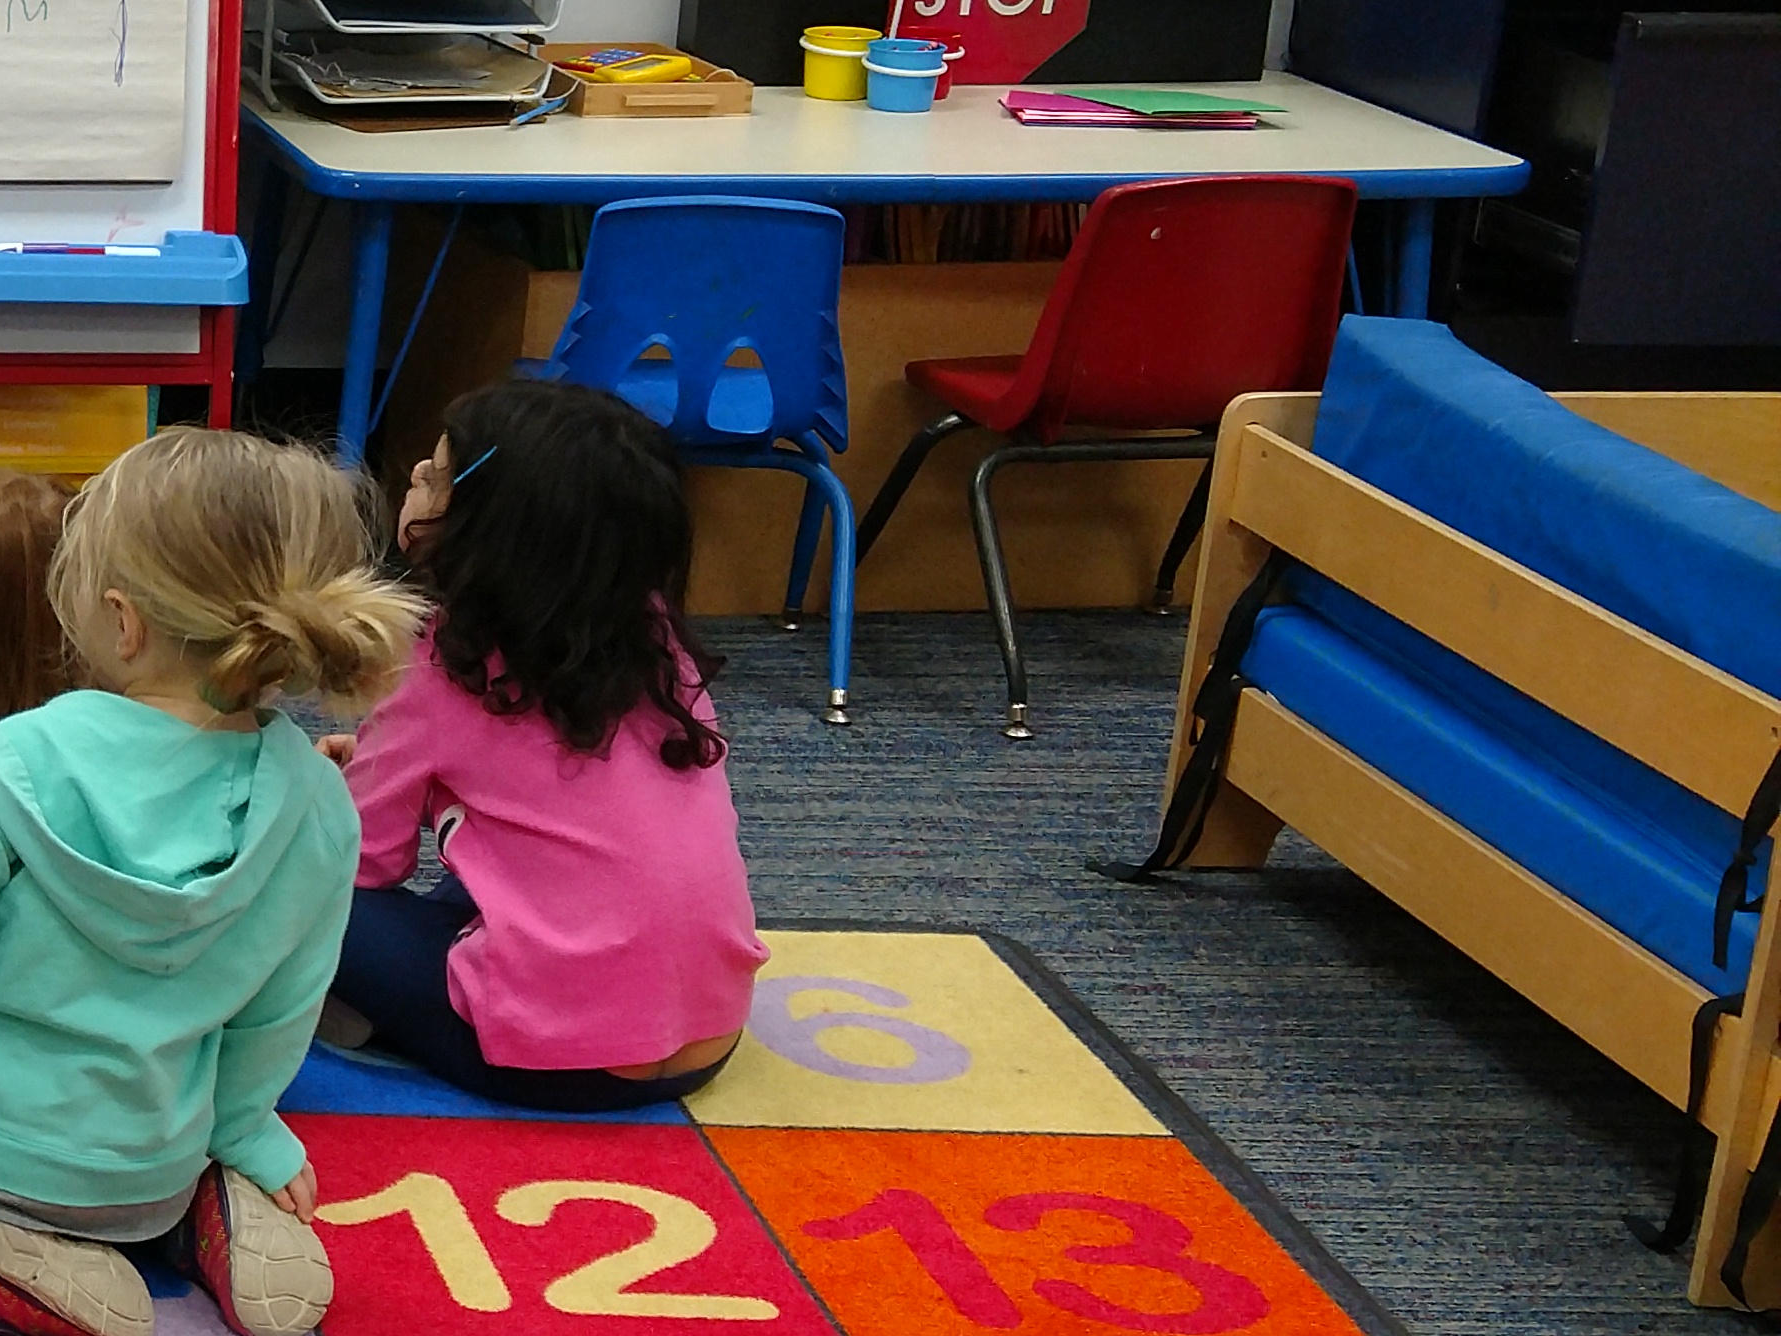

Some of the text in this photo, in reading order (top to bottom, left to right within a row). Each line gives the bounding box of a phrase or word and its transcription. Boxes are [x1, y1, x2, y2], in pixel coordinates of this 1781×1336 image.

[745, 974, 973, 1085] 6
[313, 1171, 781, 1322] 12
[805, 1187, 1272, 1336] 13
